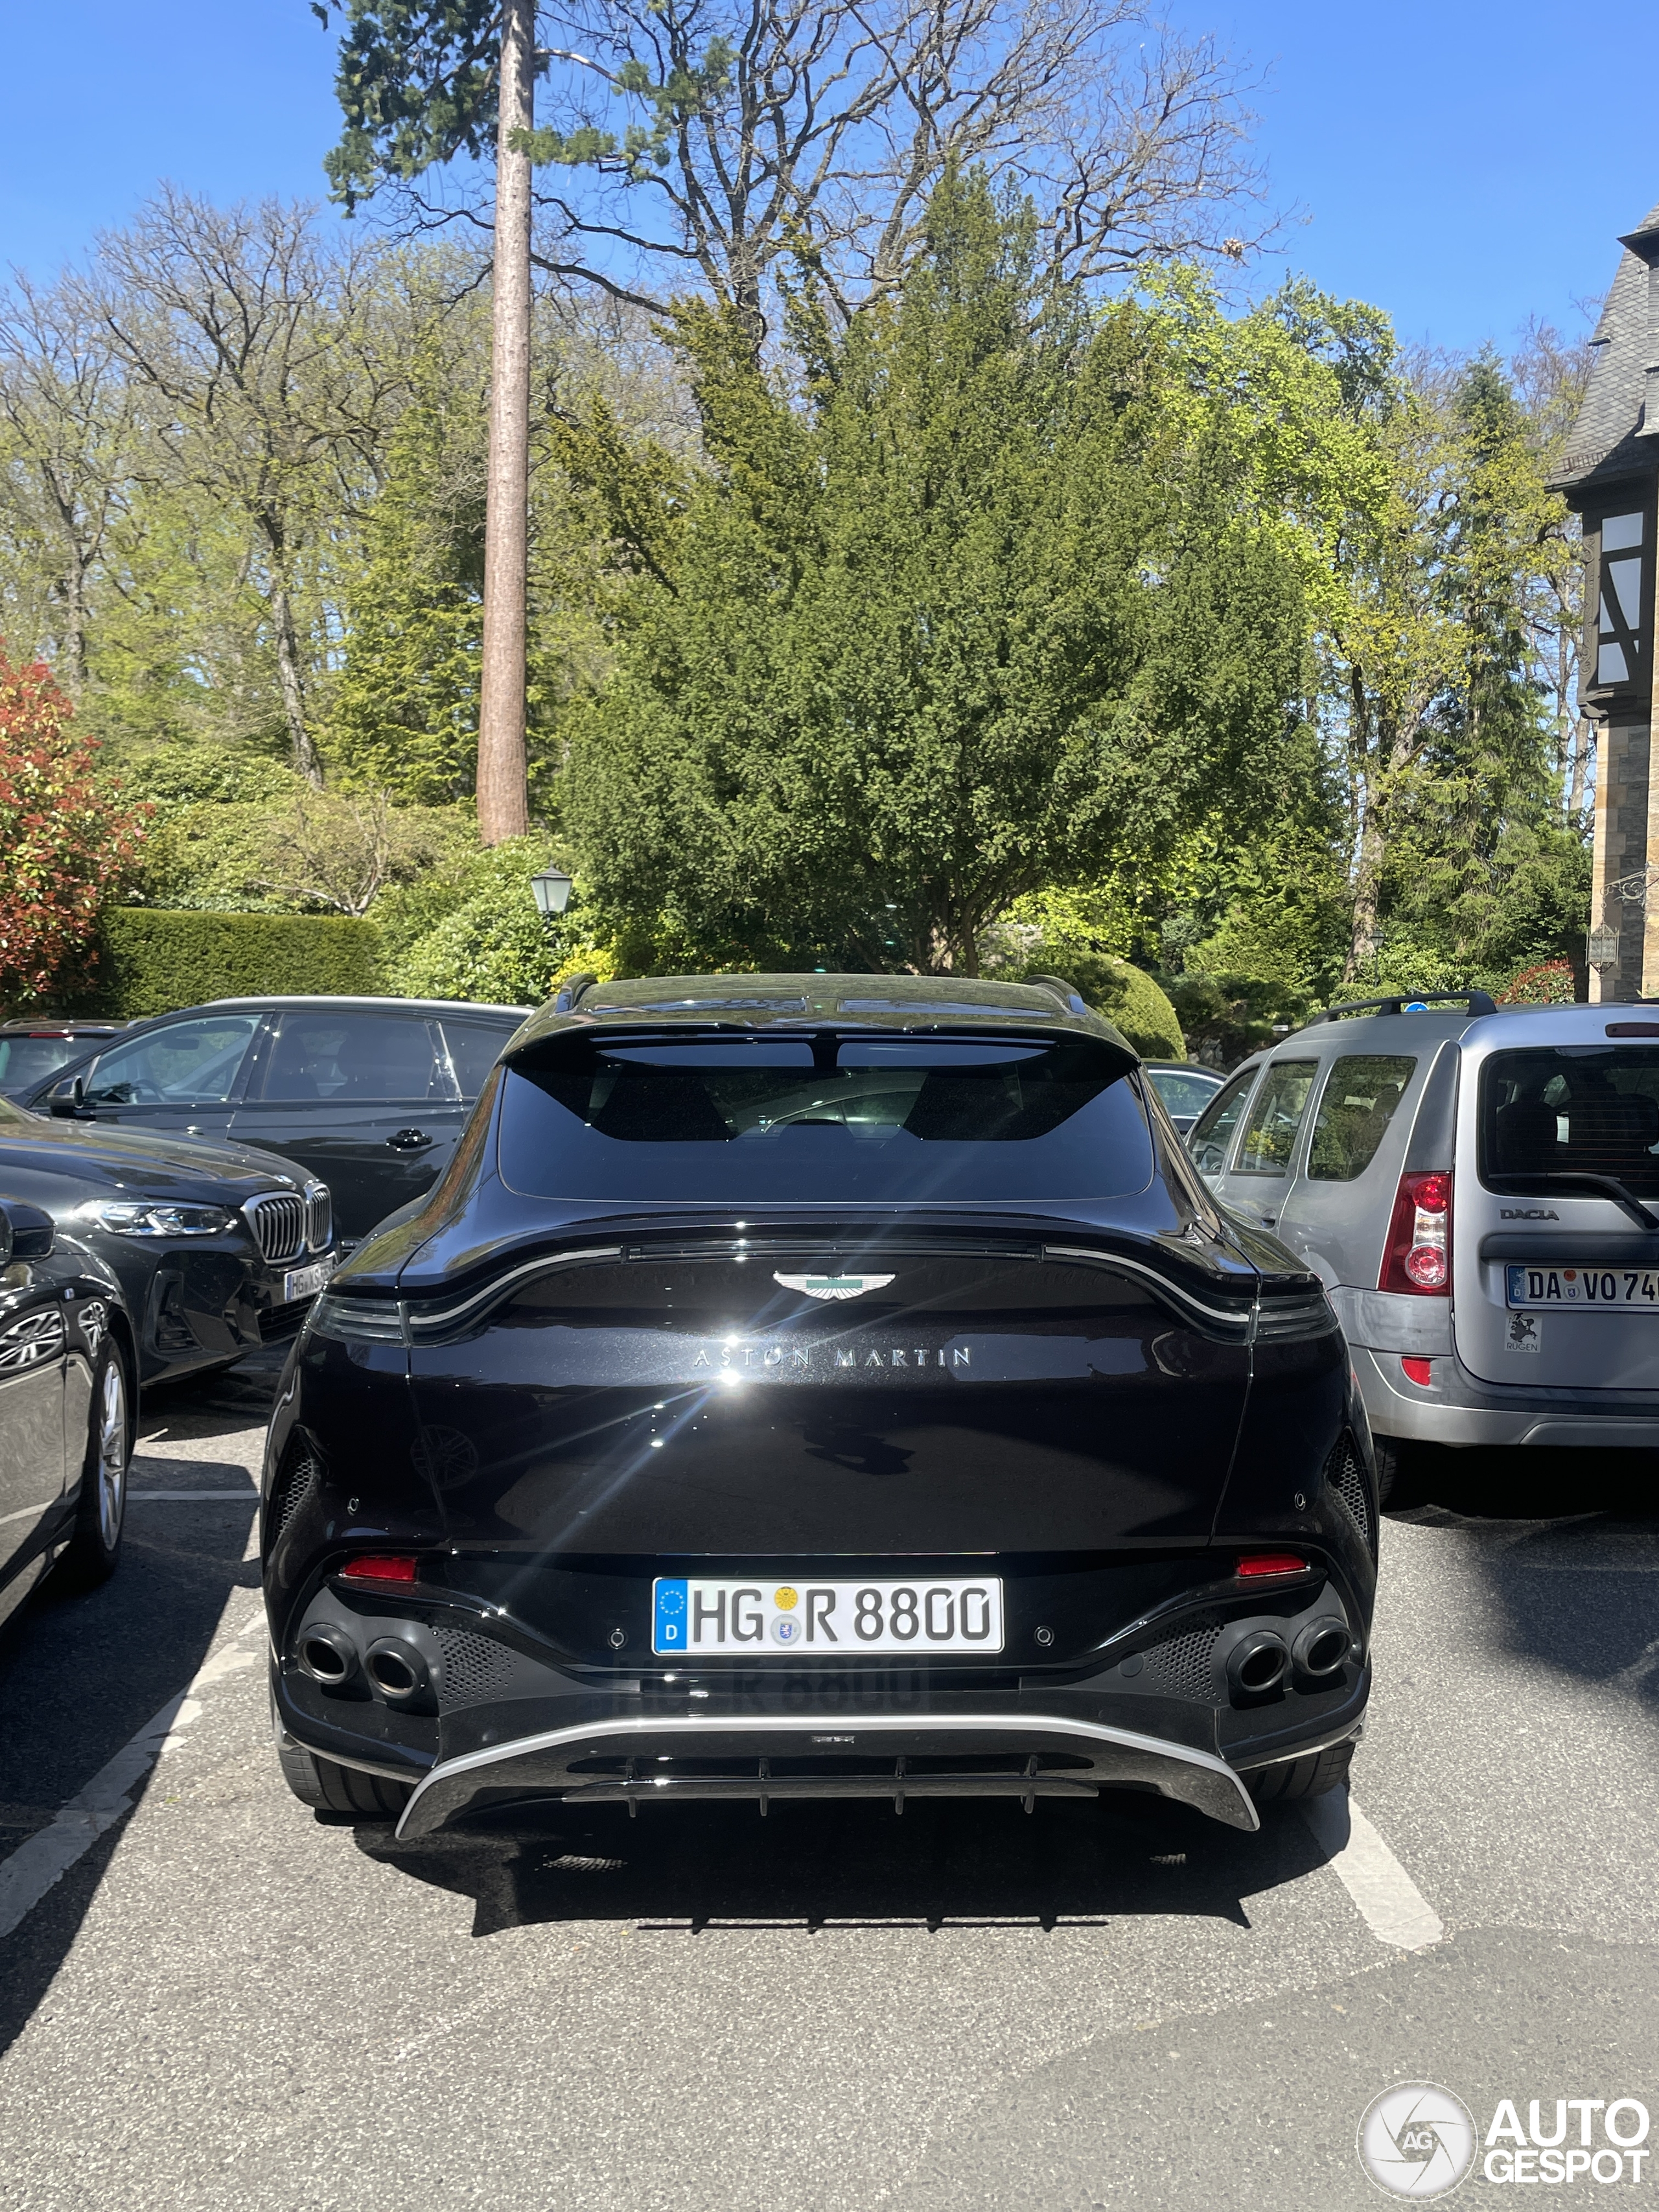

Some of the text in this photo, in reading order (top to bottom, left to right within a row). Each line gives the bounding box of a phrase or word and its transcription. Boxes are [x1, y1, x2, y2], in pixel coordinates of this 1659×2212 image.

[1499, 1209, 1560, 1221] DACIA
[292, 1274, 304, 1296] HG
[1528, 1272, 1659, 1301] DA VO 74
[1506, 1342, 1538, 1351] RÜGEN
[693, 1347, 971, 1368] ASTON MARTIN
[693, 1587, 991, 1643] HG R 8800
[666, 1625, 677, 1640] D
